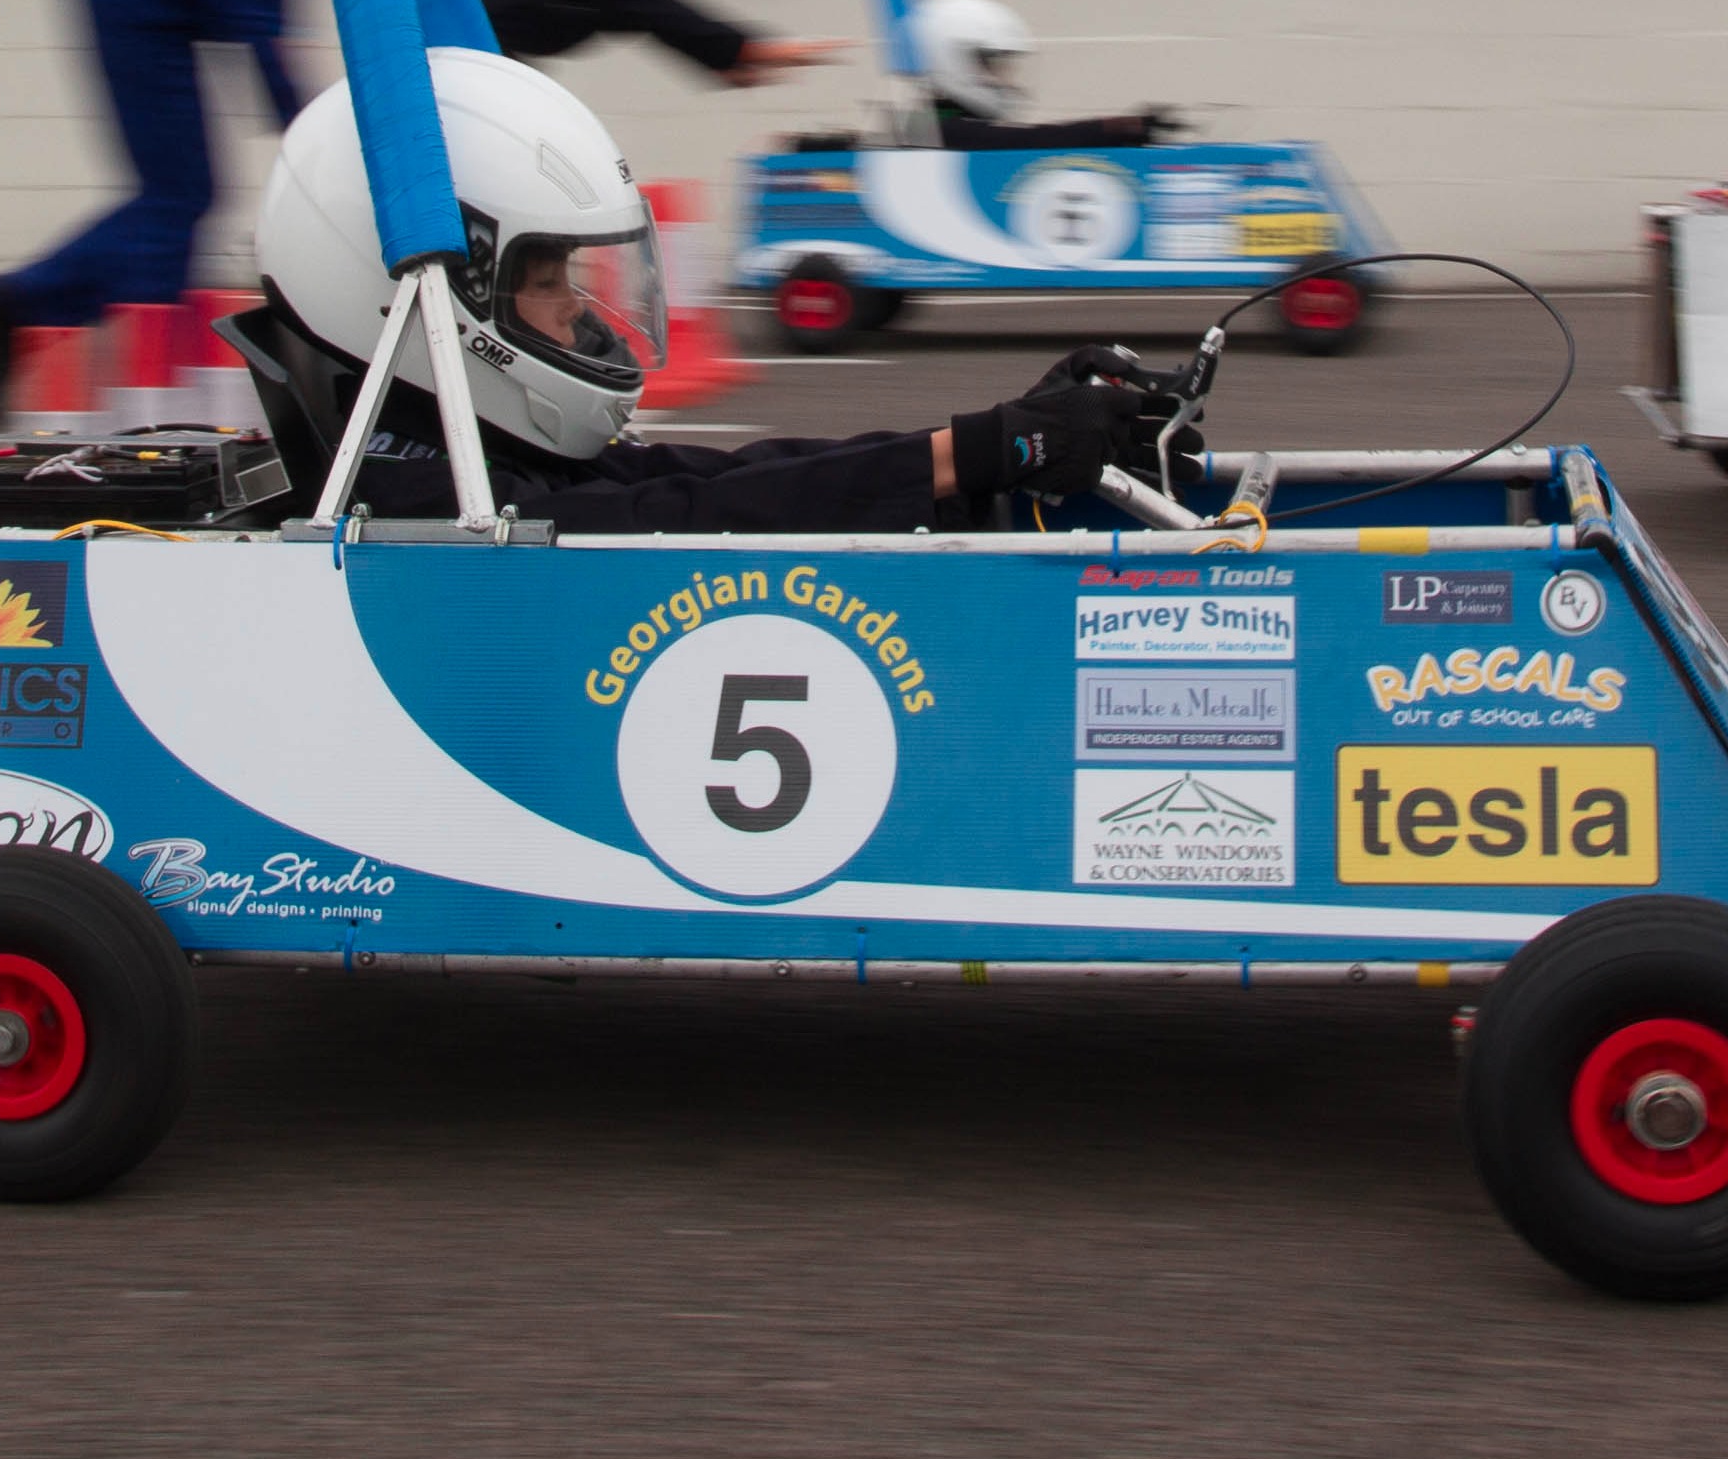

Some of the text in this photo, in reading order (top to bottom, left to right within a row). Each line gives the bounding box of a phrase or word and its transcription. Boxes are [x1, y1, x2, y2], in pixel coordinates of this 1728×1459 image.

[471, 336, 515, 367] OMP
[1208, 566, 1295, 586] Tools
[1389, 576, 1442, 611] LP
[1079, 601, 1290, 640] Harvey Smith
[585, 566, 935, 713] Georgian Gardens
[1216, 641, 1287, 654] Handyman
[1367, 645, 1626, 712] RASCALS
[1094, 687, 1166, 717] Hawke
[1186, 687, 1279, 721] Metcalfe
[1392, 707, 1597, 728] OUT OF SCHOOL CARE
[704, 674, 812, 833] 5
[1092, 733, 1278, 746] INDEPENDENT ESTATE AGENTS
[1353, 766, 1630, 858] tesla
[1093, 843, 1283, 861] WAYNE WINDOWS
[128, 837, 396, 916] Bay Studio
[1089, 864, 1285, 882] & CONSERVATORIES
[187, 899, 383, 921] signs designs printing
